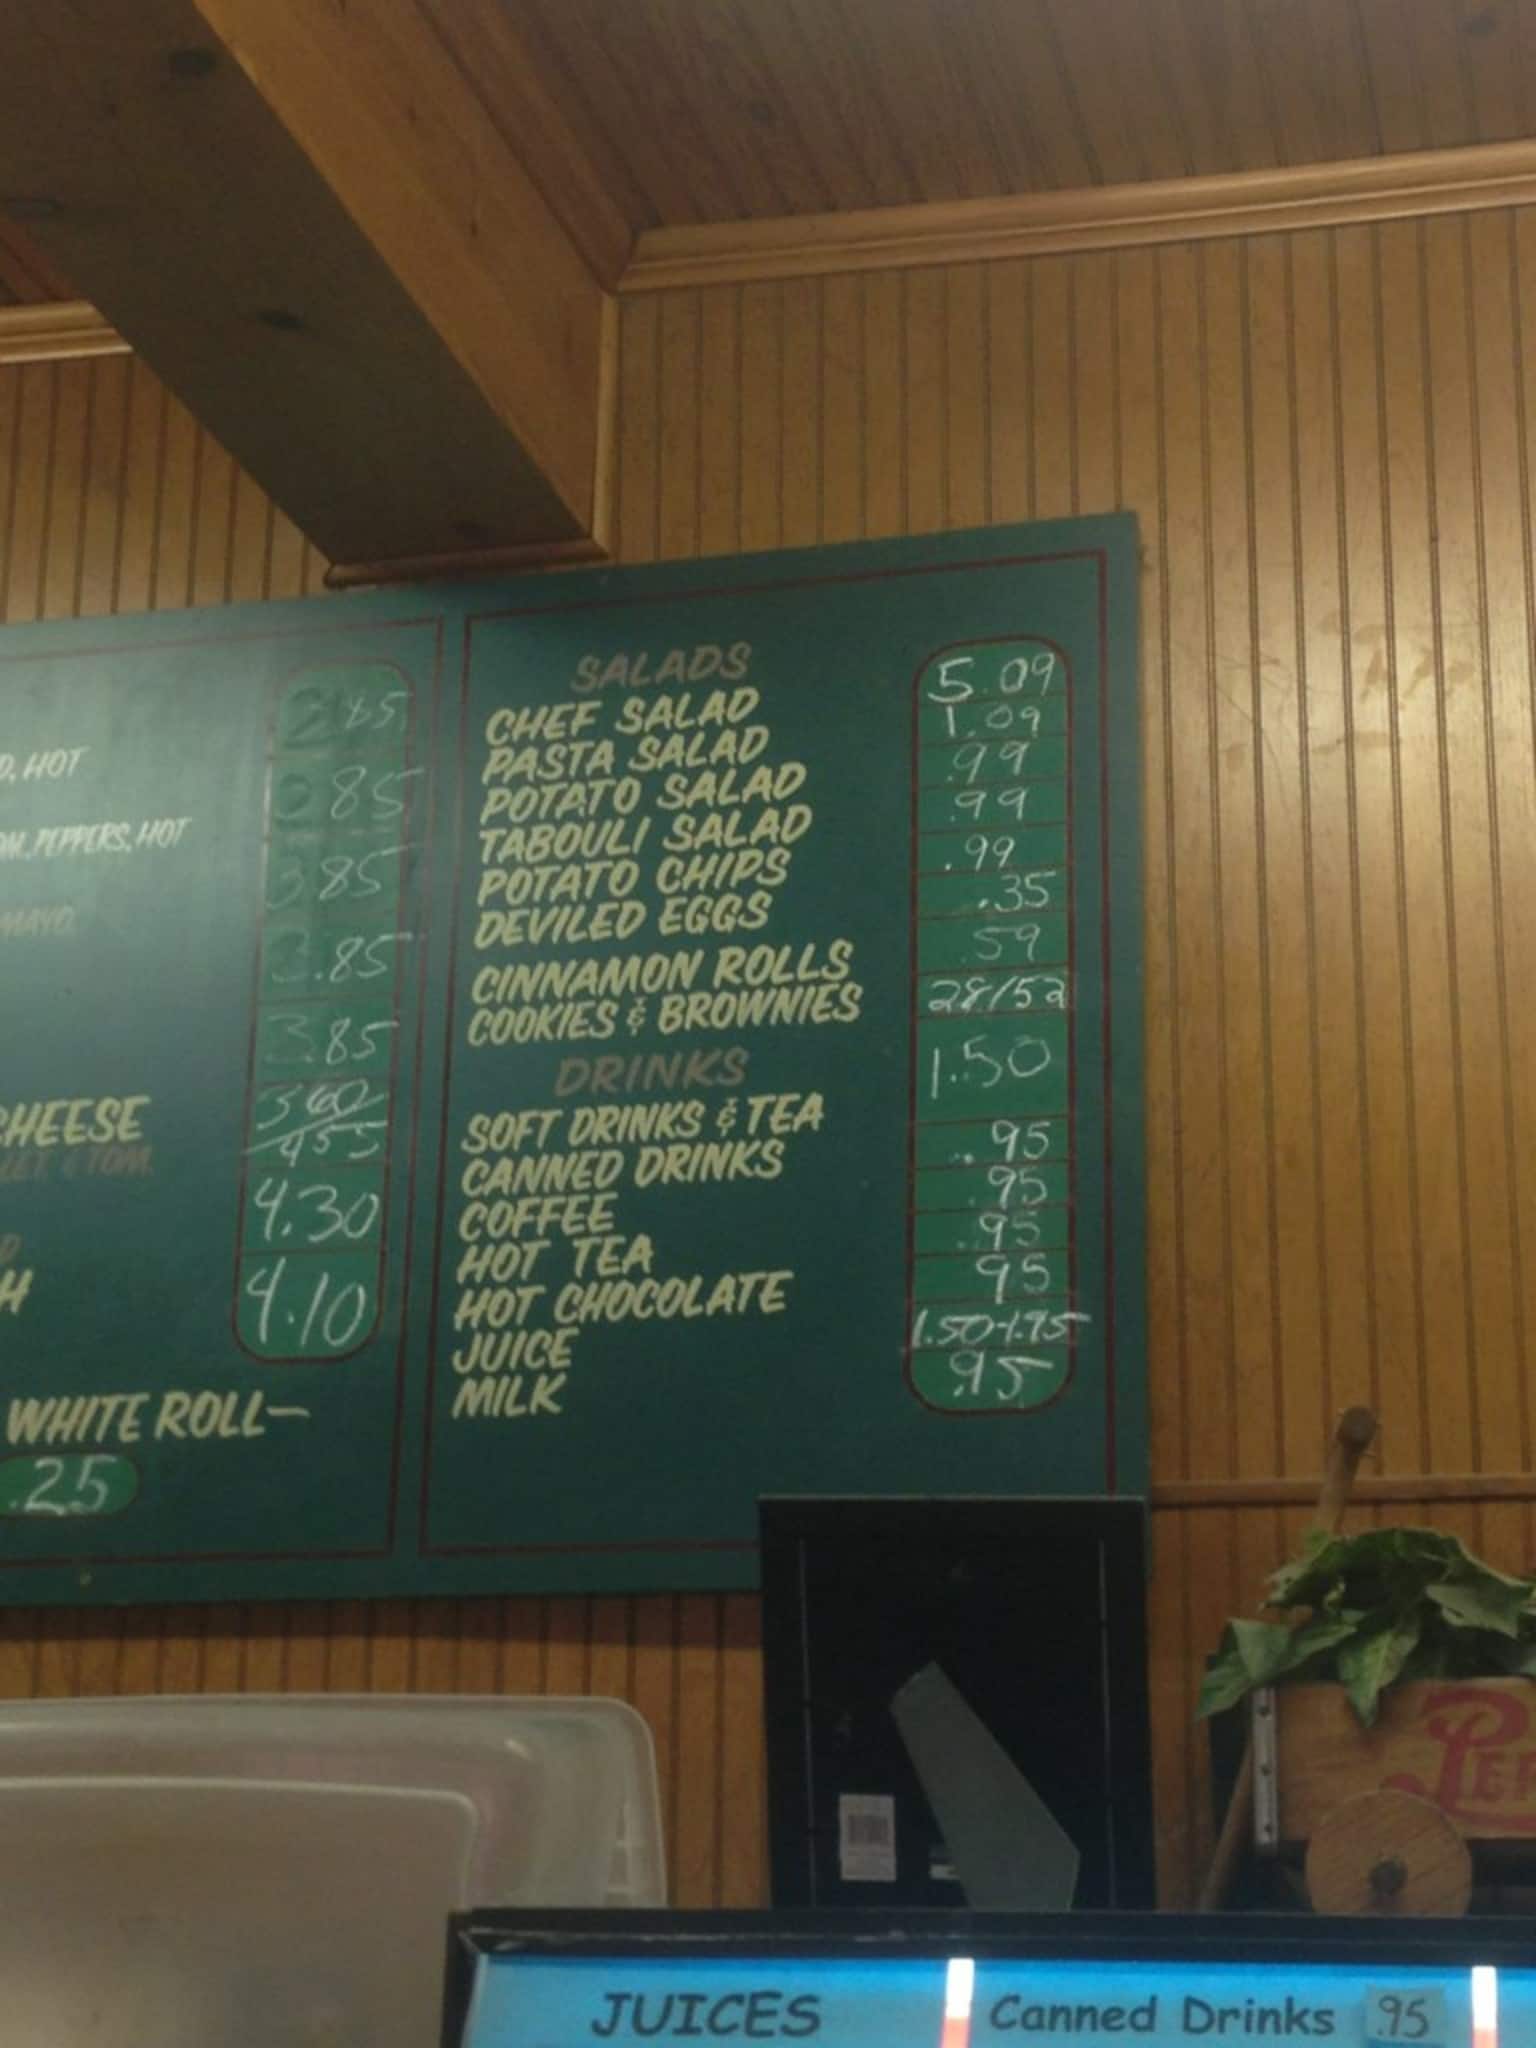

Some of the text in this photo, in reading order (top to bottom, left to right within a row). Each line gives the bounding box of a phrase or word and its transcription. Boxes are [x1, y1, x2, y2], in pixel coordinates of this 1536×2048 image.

[571, 641, 752, 693] SALADS
[485, 686, 760, 746] CHEF SALAD
[22, 745, 91, 781] HOT
[482, 724, 769, 784] PASTA SALAD
[480, 761, 807, 824] POTATO SALAD
[479, 805, 812, 864] TABOULI SALAD
[944, 833, 1016, 872] .99
[477, 847, 791, 906] POTATO CHIPS
[977, 870, 1057, 912] .35
[474, 890, 773, 949] DEVILED EGGS
[471, 938, 854, 1005] CINNAMON ROLLS
[467, 982, 863, 1047] COOKIES & BROWNIES
[555, 1047, 750, 1096] DRINKS
[930, 1033, 1052, 1100] 1.50
[461, 1092, 825, 1154] SOFT DRINKS & TEA
[461, 1139, 785, 1198] CANNED DRINKS
[254, 1177, 380, 1243] 4.30
[459, 1192, 618, 1242] COFFEE
[456, 1234, 655, 1284] HOT TEA
[245, 1256, 366, 1347] 4.10
[454, 1270, 794, 1330] HOT CHOCOLATE
[451, 1328, 579, 1374] JUICE
[6, 1393, 150, 1446] WHITE
[452, 1373, 567, 1419] MILK
[592, 1990, 821, 2038] JUICES
[989, 1994, 1336, 2037] Canned Drinks
